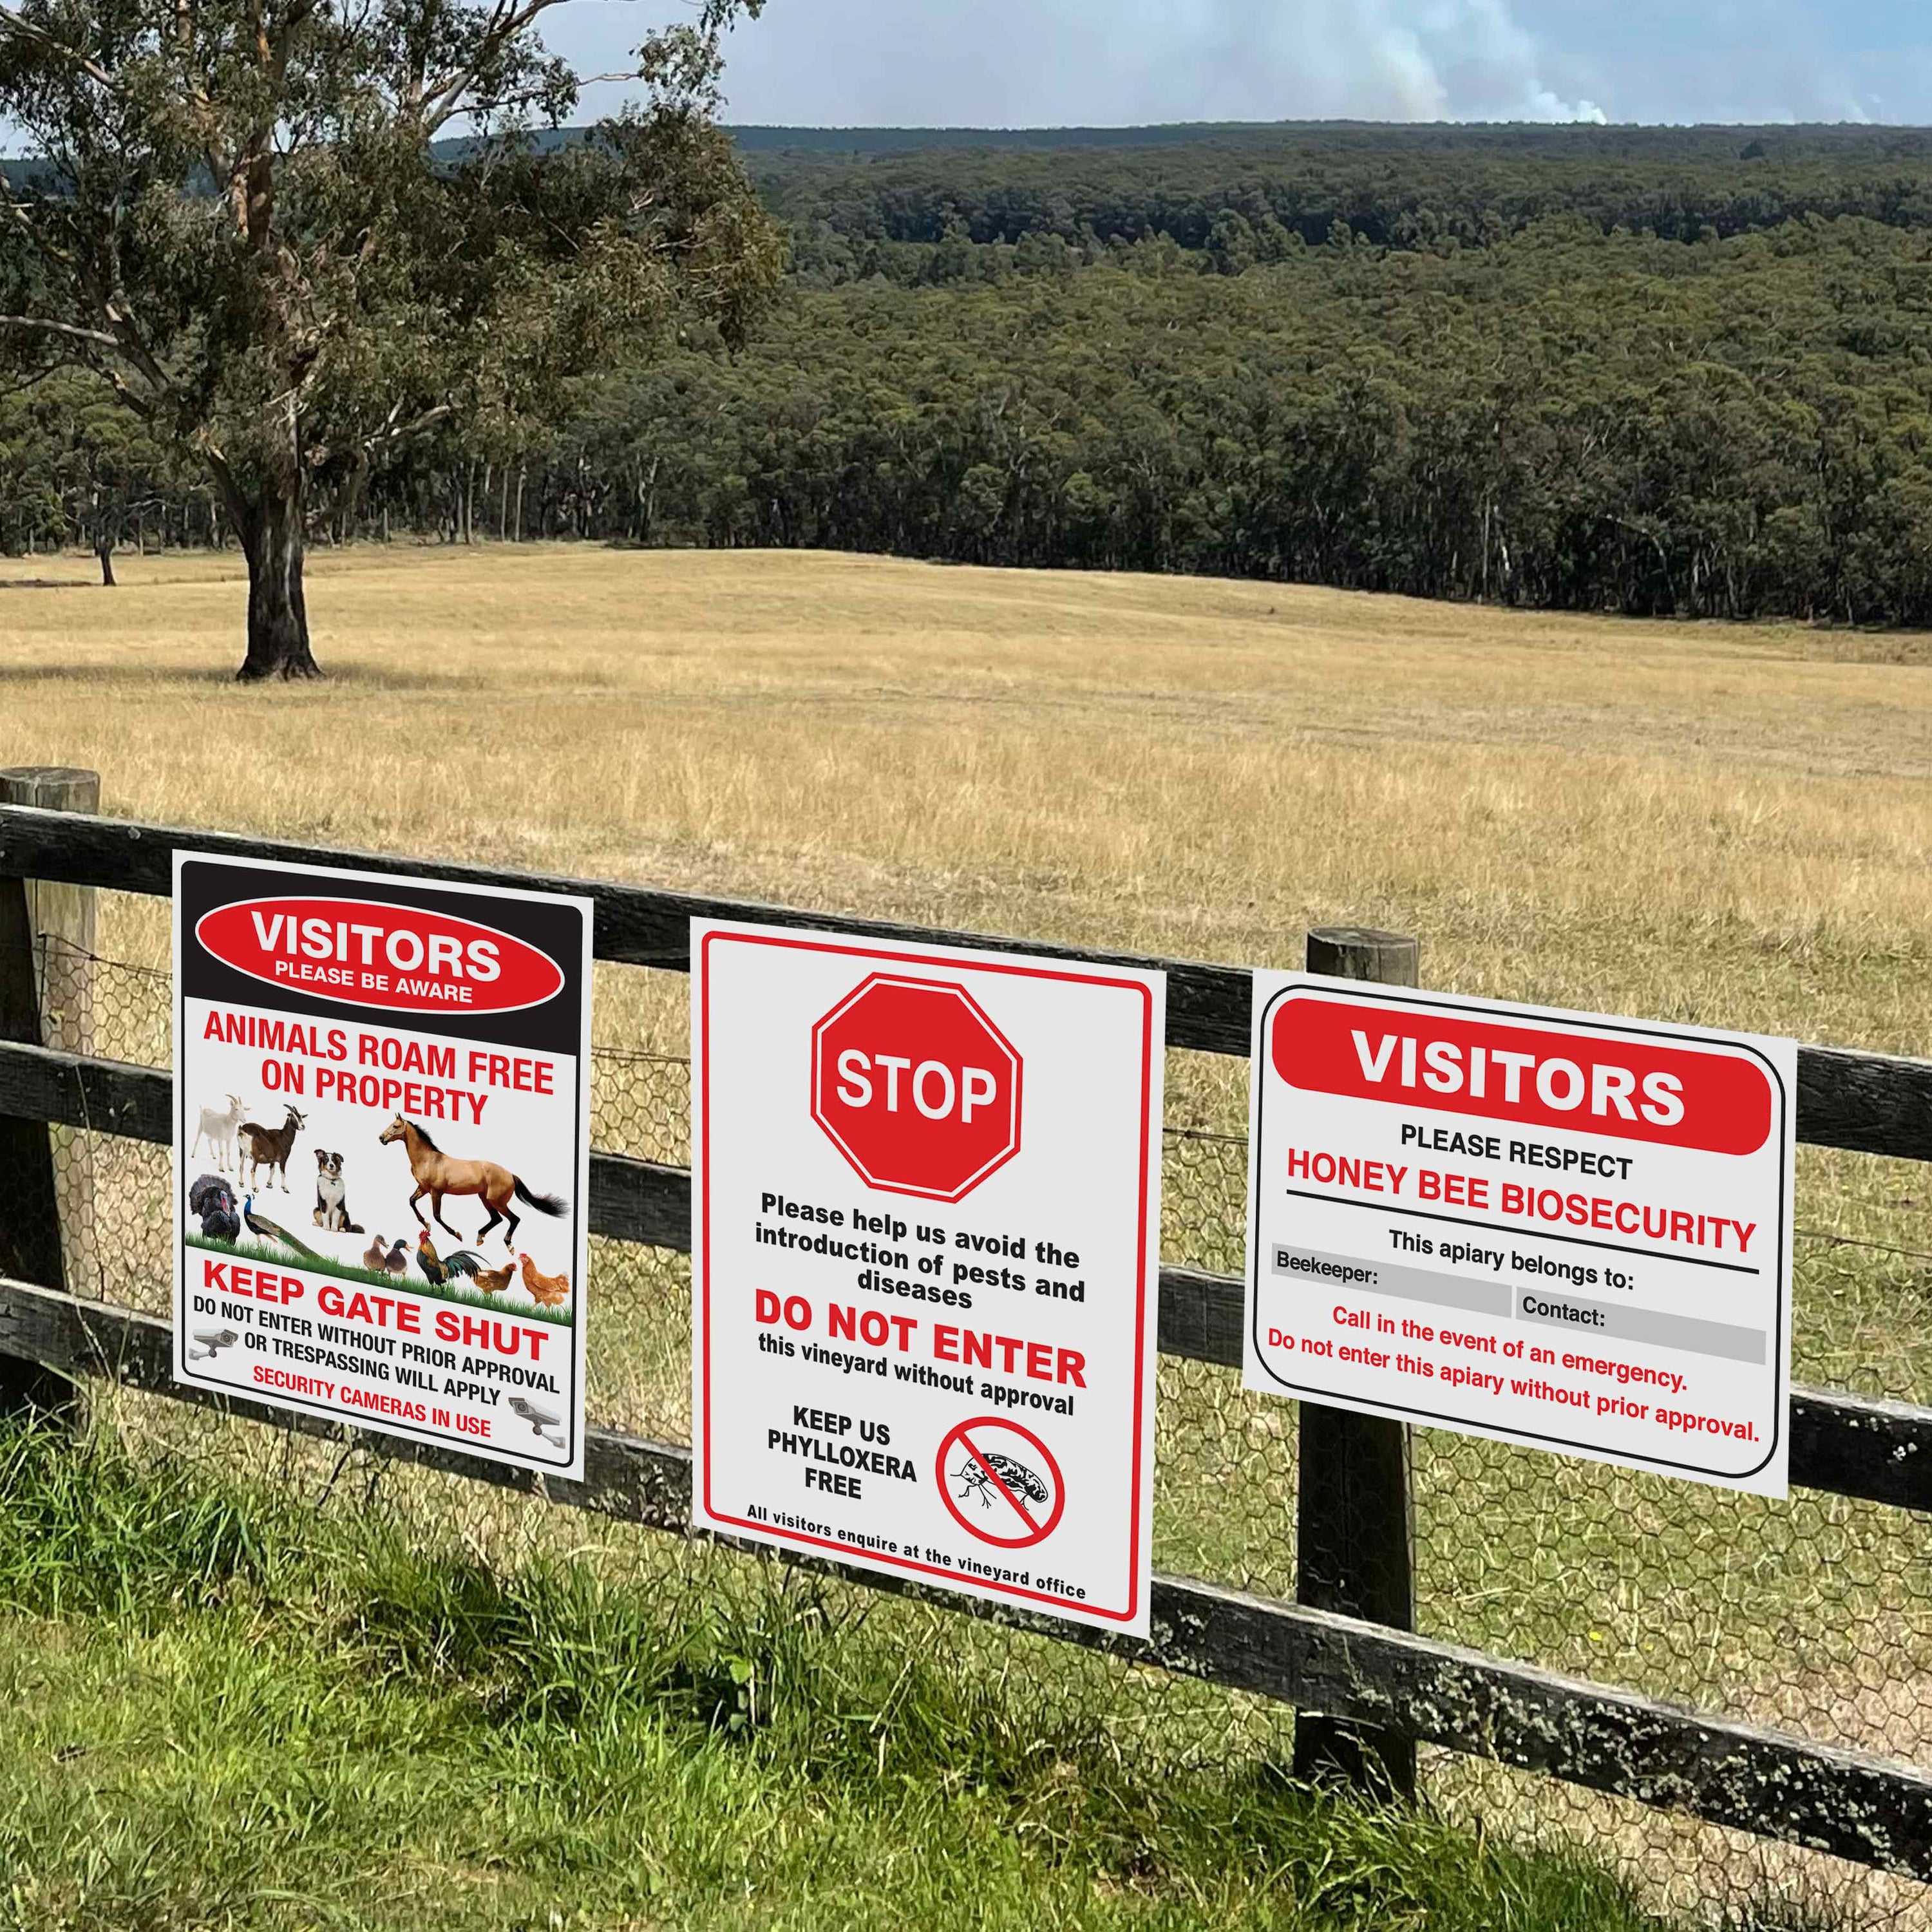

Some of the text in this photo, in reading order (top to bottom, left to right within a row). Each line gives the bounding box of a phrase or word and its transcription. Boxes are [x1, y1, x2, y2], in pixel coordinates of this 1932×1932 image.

[251, 911, 500, 983] VISITORS
[276, 961, 472, 1003] PLEASE BE AWARE
[204, 1011, 553, 1095] ANIMALS ROAM FREE
[837, 1050, 996, 1123] STOP
[1351, 1030, 1684, 1126] VISITORS
[262, 1059, 488, 1124] ON PROPERTY
[1402, 1124, 1633, 1180] PLEASE RESPECT
[762, 1193, 1079, 1268] Please help us avoid the
[1289, 1148, 1756, 1252] HONEY BEE BIOSECURITY
[756, 1221, 1084, 1302] introduction of pests and
[858, 1269, 972, 1309] diseases
[1278, 1251, 1377, 1284] Beekeeper:
[1389, 1229, 1633, 1290] This apiary belongs to:
[194, 1296, 560, 1394] DO NOT ENTER WITHOUT PRIOR APPROVAL
[205, 1260, 548, 1361] KEEP GATE SHUT
[756, 1289, 1086, 1389] DO NOT ENTER
[1523, 1296, 1604, 1326] Contact:
[245, 1332, 500, 1405] OR TRESPASSING WILL APPLY
[759, 1333, 1073, 1416] this vineyard without approval
[1269, 1329, 1759, 1441] Do not enter this apiary without prior approval.
[1334, 1306, 1687, 1393] Call in the event of an emergency.
[254, 1366, 490, 1437] SECURITY CAMERAS IN USE
[794, 1405, 890, 1445] KEEP US
[769, 1429, 916, 1482] PHYLLOXERA
[806, 1468, 861, 1499] FREE
[748, 1505, 1085, 1598] All visitors enquire at the vineyard office
